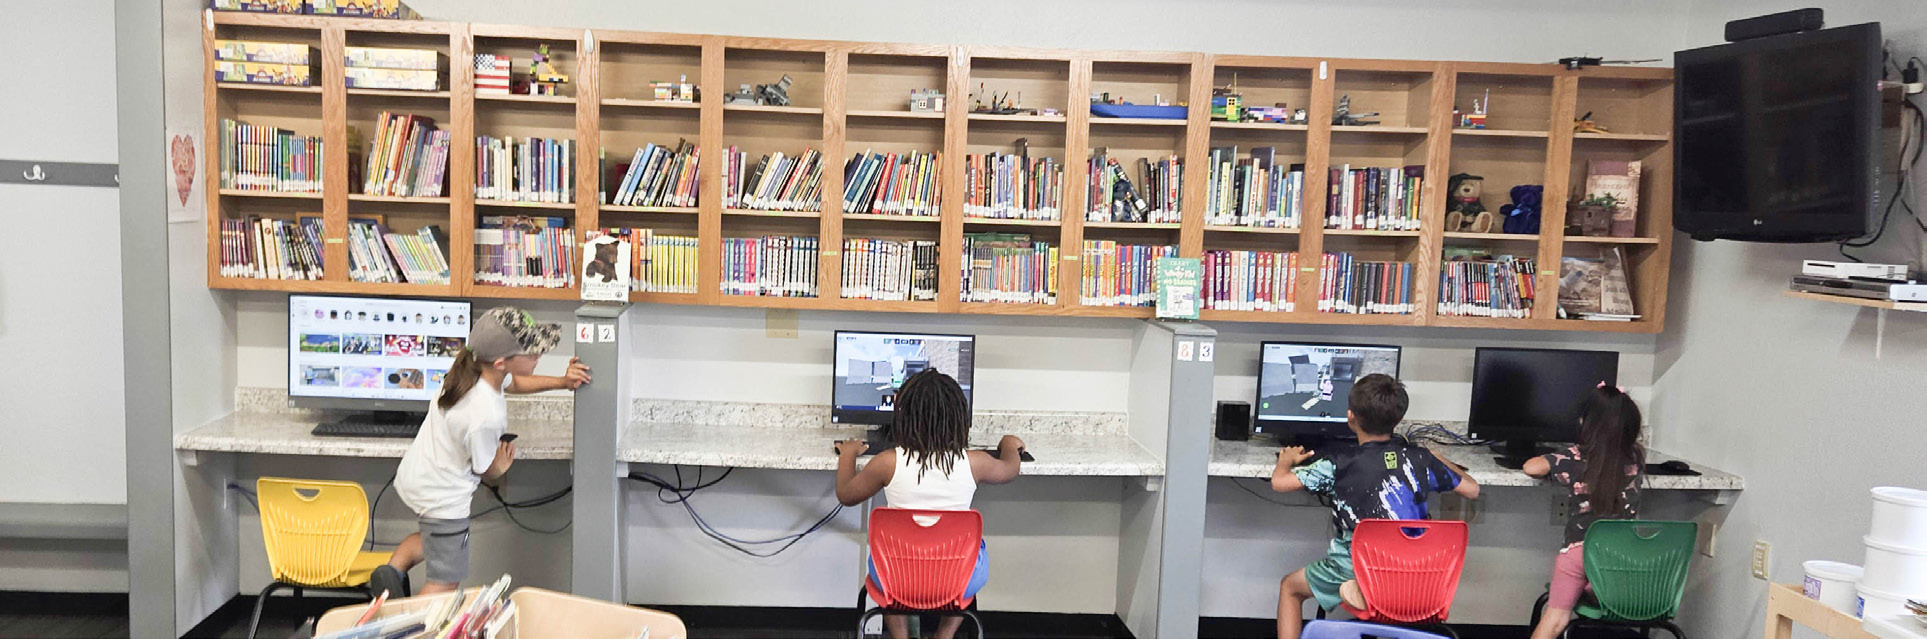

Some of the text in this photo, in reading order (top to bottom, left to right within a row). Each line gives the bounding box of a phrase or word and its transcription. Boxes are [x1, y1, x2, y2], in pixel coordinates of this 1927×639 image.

[581, 327, 589, 339] 6
[603, 328, 611, 339] 2
[1181, 344, 1189, 357] 8
[1202, 345, 1210, 357] 3
